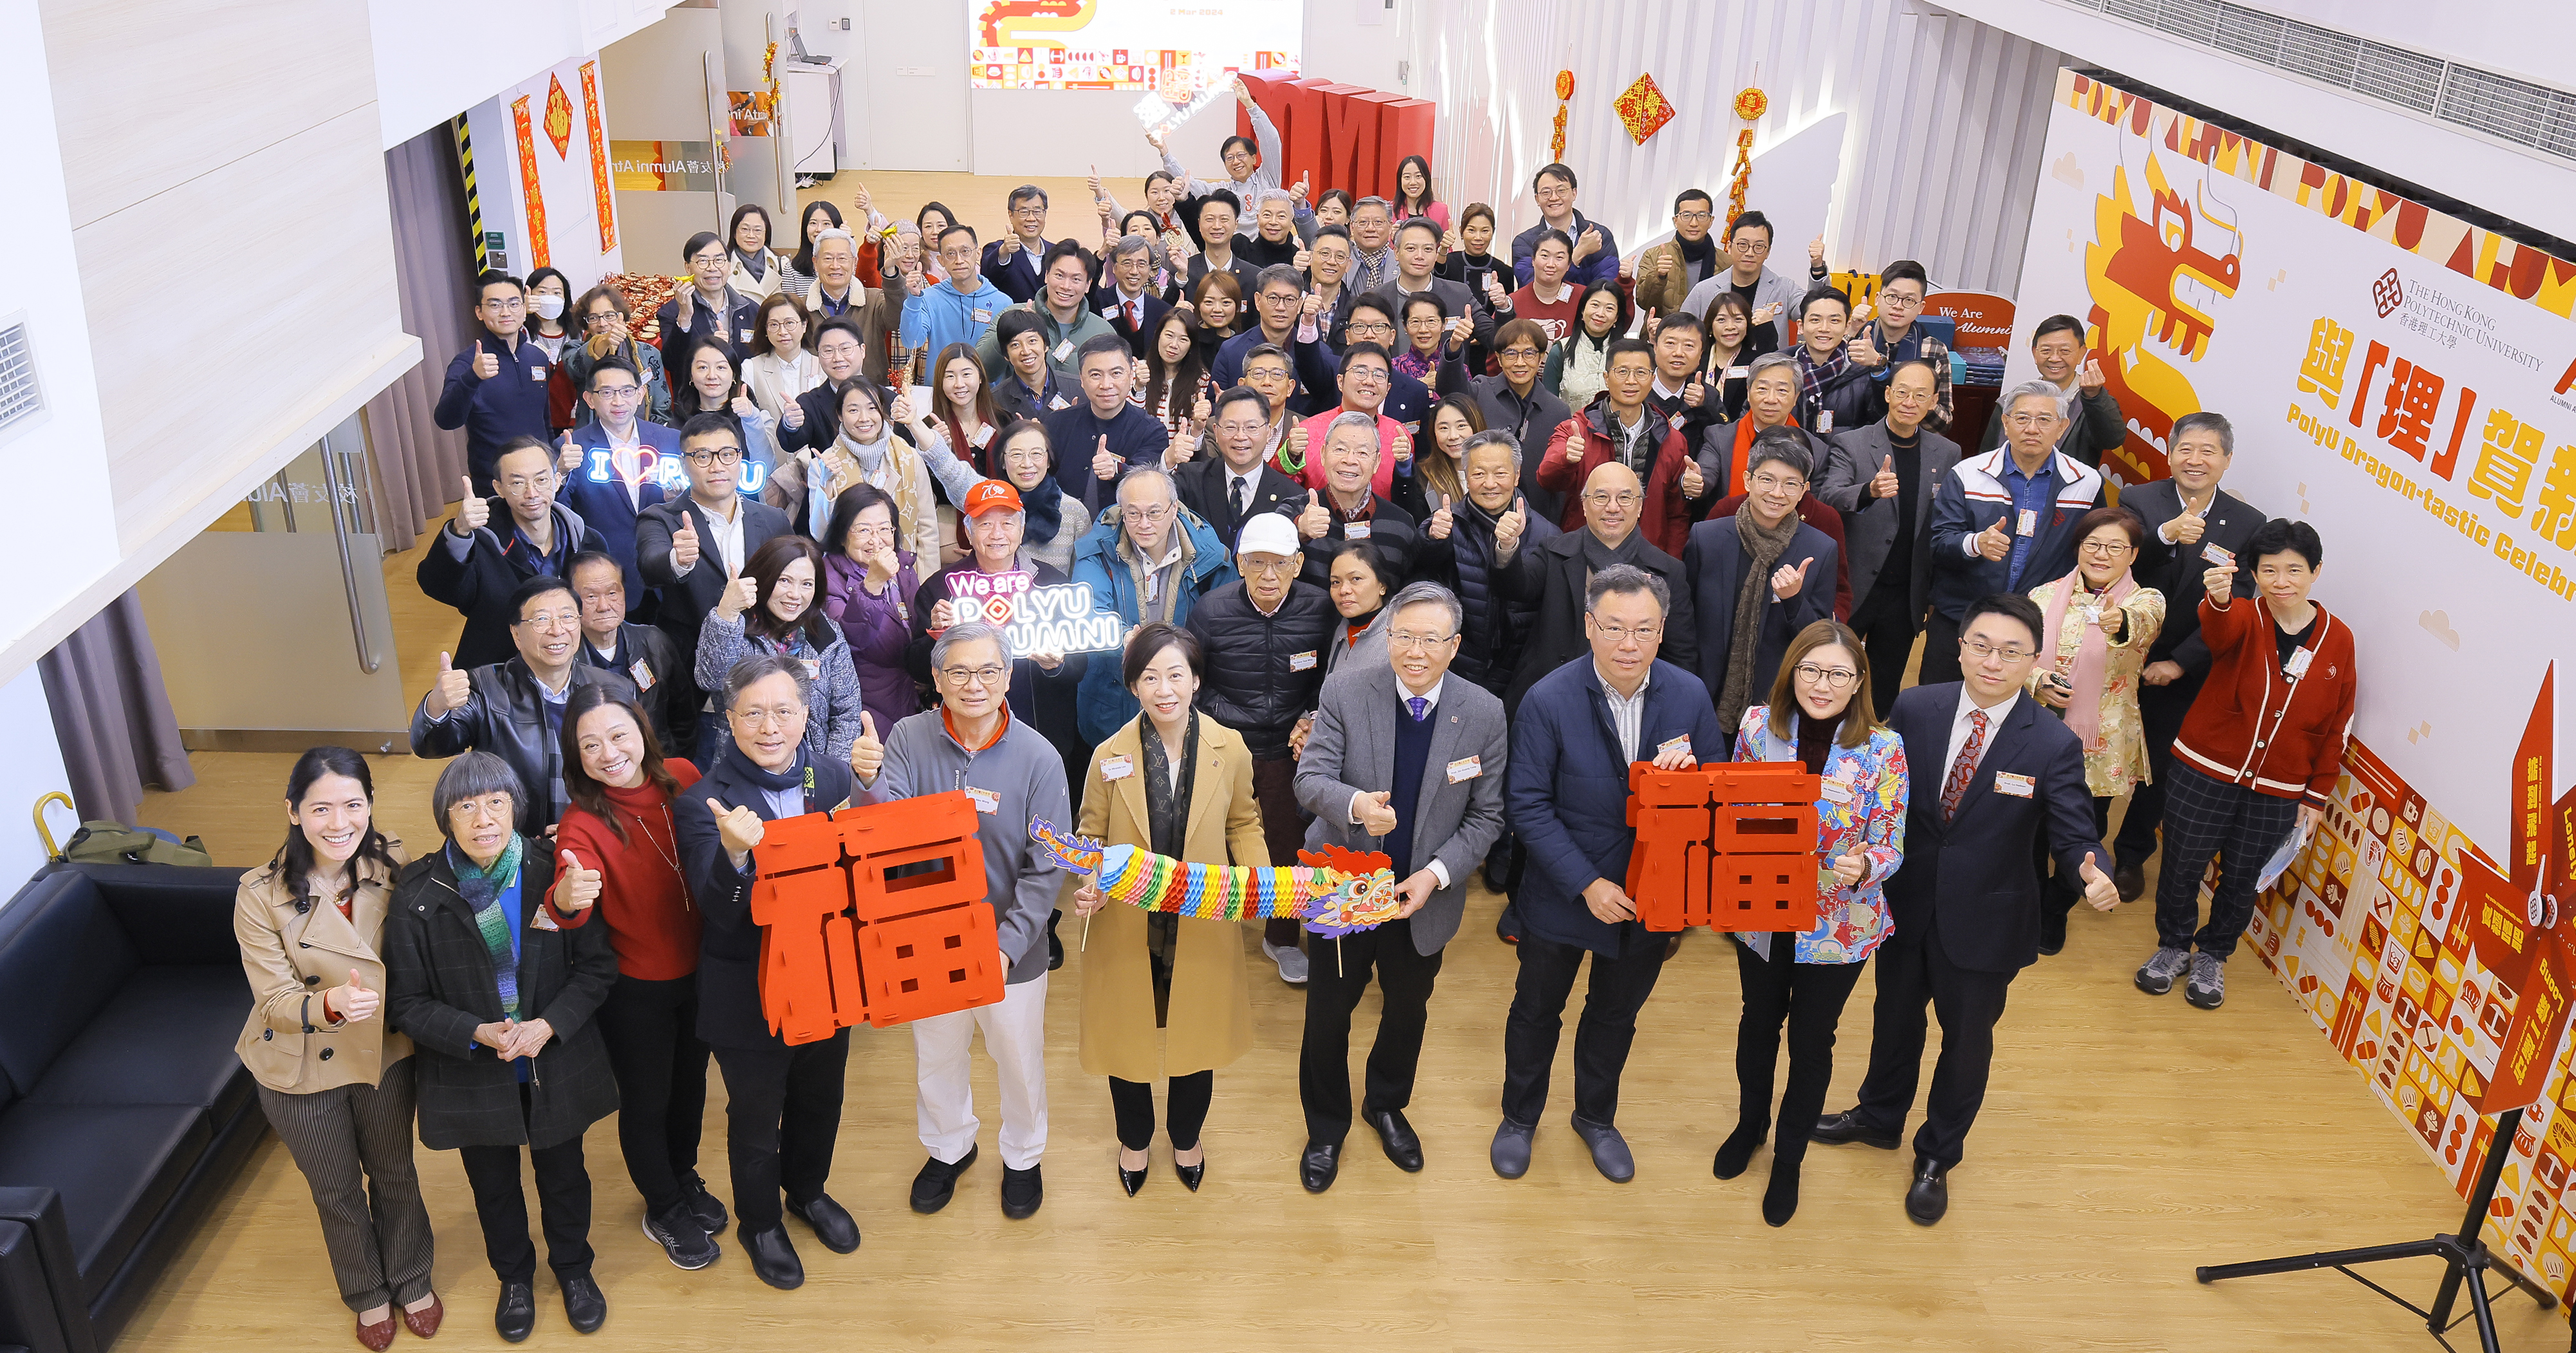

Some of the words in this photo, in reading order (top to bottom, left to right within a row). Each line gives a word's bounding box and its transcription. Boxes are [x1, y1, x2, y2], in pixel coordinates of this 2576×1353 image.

[550, 88, 568, 138] 福
[1939, 306, 1958, 317] We
[1960, 308, 1983, 319] Are
[1955, 322, 2014, 335] Alumni
[2409, 279, 2430, 303] THE
[2431, 288, 2463, 317] HONG
[2465, 304, 2497, 332] KONG
[2398, 310, 2458, 351] 香港理工大學
[2404, 295, 2474, 341] POLYTECHNIC
[2476, 330, 2544, 373] UNIVERSITY
[2550, 395, 2571, 411] ALUMNI
[2286, 402, 2341, 451] PolyU
[2340, 435, 2490, 548] Dragon-tastic
[949, 575, 989, 597] We
[992, 574, 1031, 594] are
[1005, 615, 1122, 657] UMNI
[1625, 760, 1821, 933] 福
[750, 789, 1006, 1047] 福
